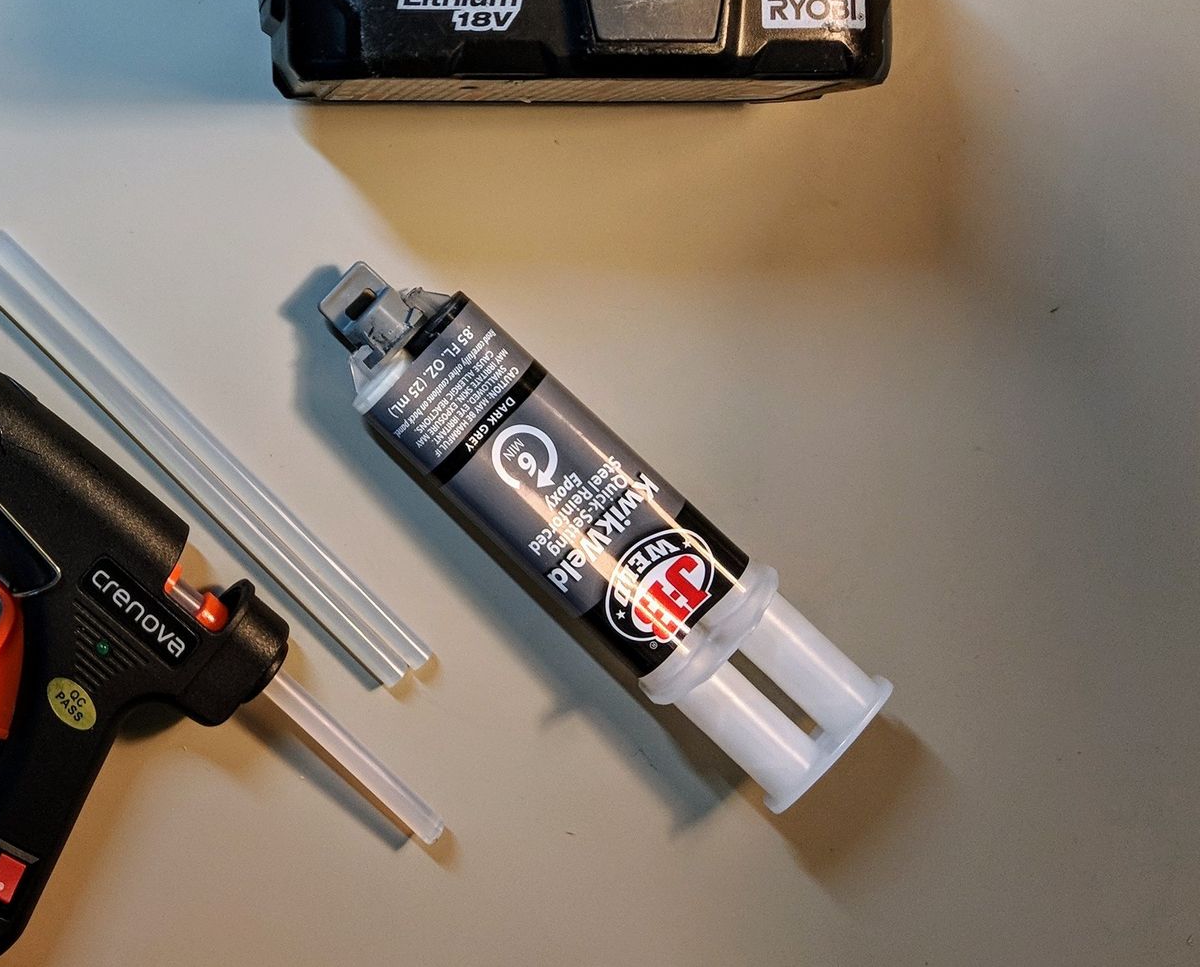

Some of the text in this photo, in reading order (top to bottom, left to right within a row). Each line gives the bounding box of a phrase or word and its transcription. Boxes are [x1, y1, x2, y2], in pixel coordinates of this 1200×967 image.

[458, 10, 514, 30] 18V
[386, 324, 477, 419] .85 FL. OZ. (25 mL)
[446, 362, 465, 381] other
[458, 338, 487, 367] carefully
[412, 349, 495, 435] CAUSE ALLERGIC REACTIONS.
[413, 347, 508, 448] MAY IRRITATE SKIN. EXPOSURE MAY
[418, 399, 430, 411] on
[425, 376, 451, 403] cautions
[430, 363, 507, 445] SWALLOWED. EYE IRRITANT.
[392, 419, 411, 438] panel.
[406, 407, 423, 424] back
[432, 365, 520, 458] CAUTION: MAY BE HARMFUL IF
[462, 395, 516, 452] DARK GREY
[501, 437, 525, 461] MIN
[515, 449, 540, 477] 6
[527, 454, 621, 556] Steel Reinforced
[544, 470, 583, 512] Epoxy
[546, 473, 629, 558] Quick-Setting
[546, 472, 660, 594] KwikWeld
[614, 539, 680, 607] WELD
[91, 568, 186, 659] crenova
[55, 691, 84, 722] PASS
[70, 689, 87, 707] QC
